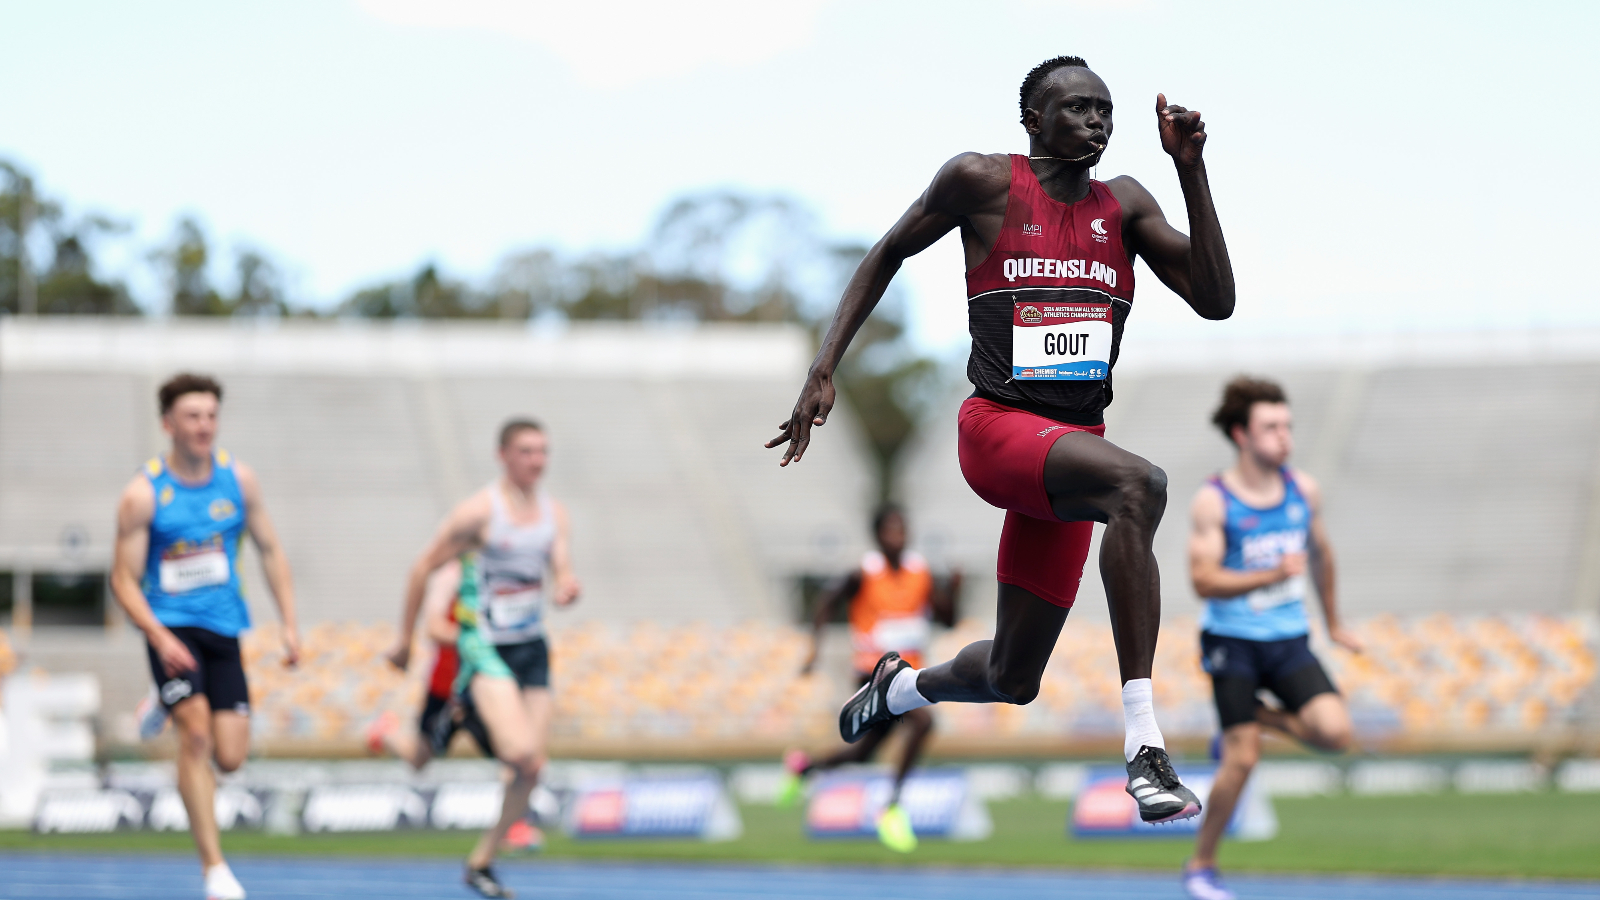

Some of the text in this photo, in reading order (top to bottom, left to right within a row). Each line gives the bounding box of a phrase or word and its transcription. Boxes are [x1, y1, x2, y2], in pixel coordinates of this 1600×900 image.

[1023, 223, 1042, 232] IMPI
[1003, 258, 1117, 288] QUEENSLAND
[1044, 333, 1089, 355] GOUT
